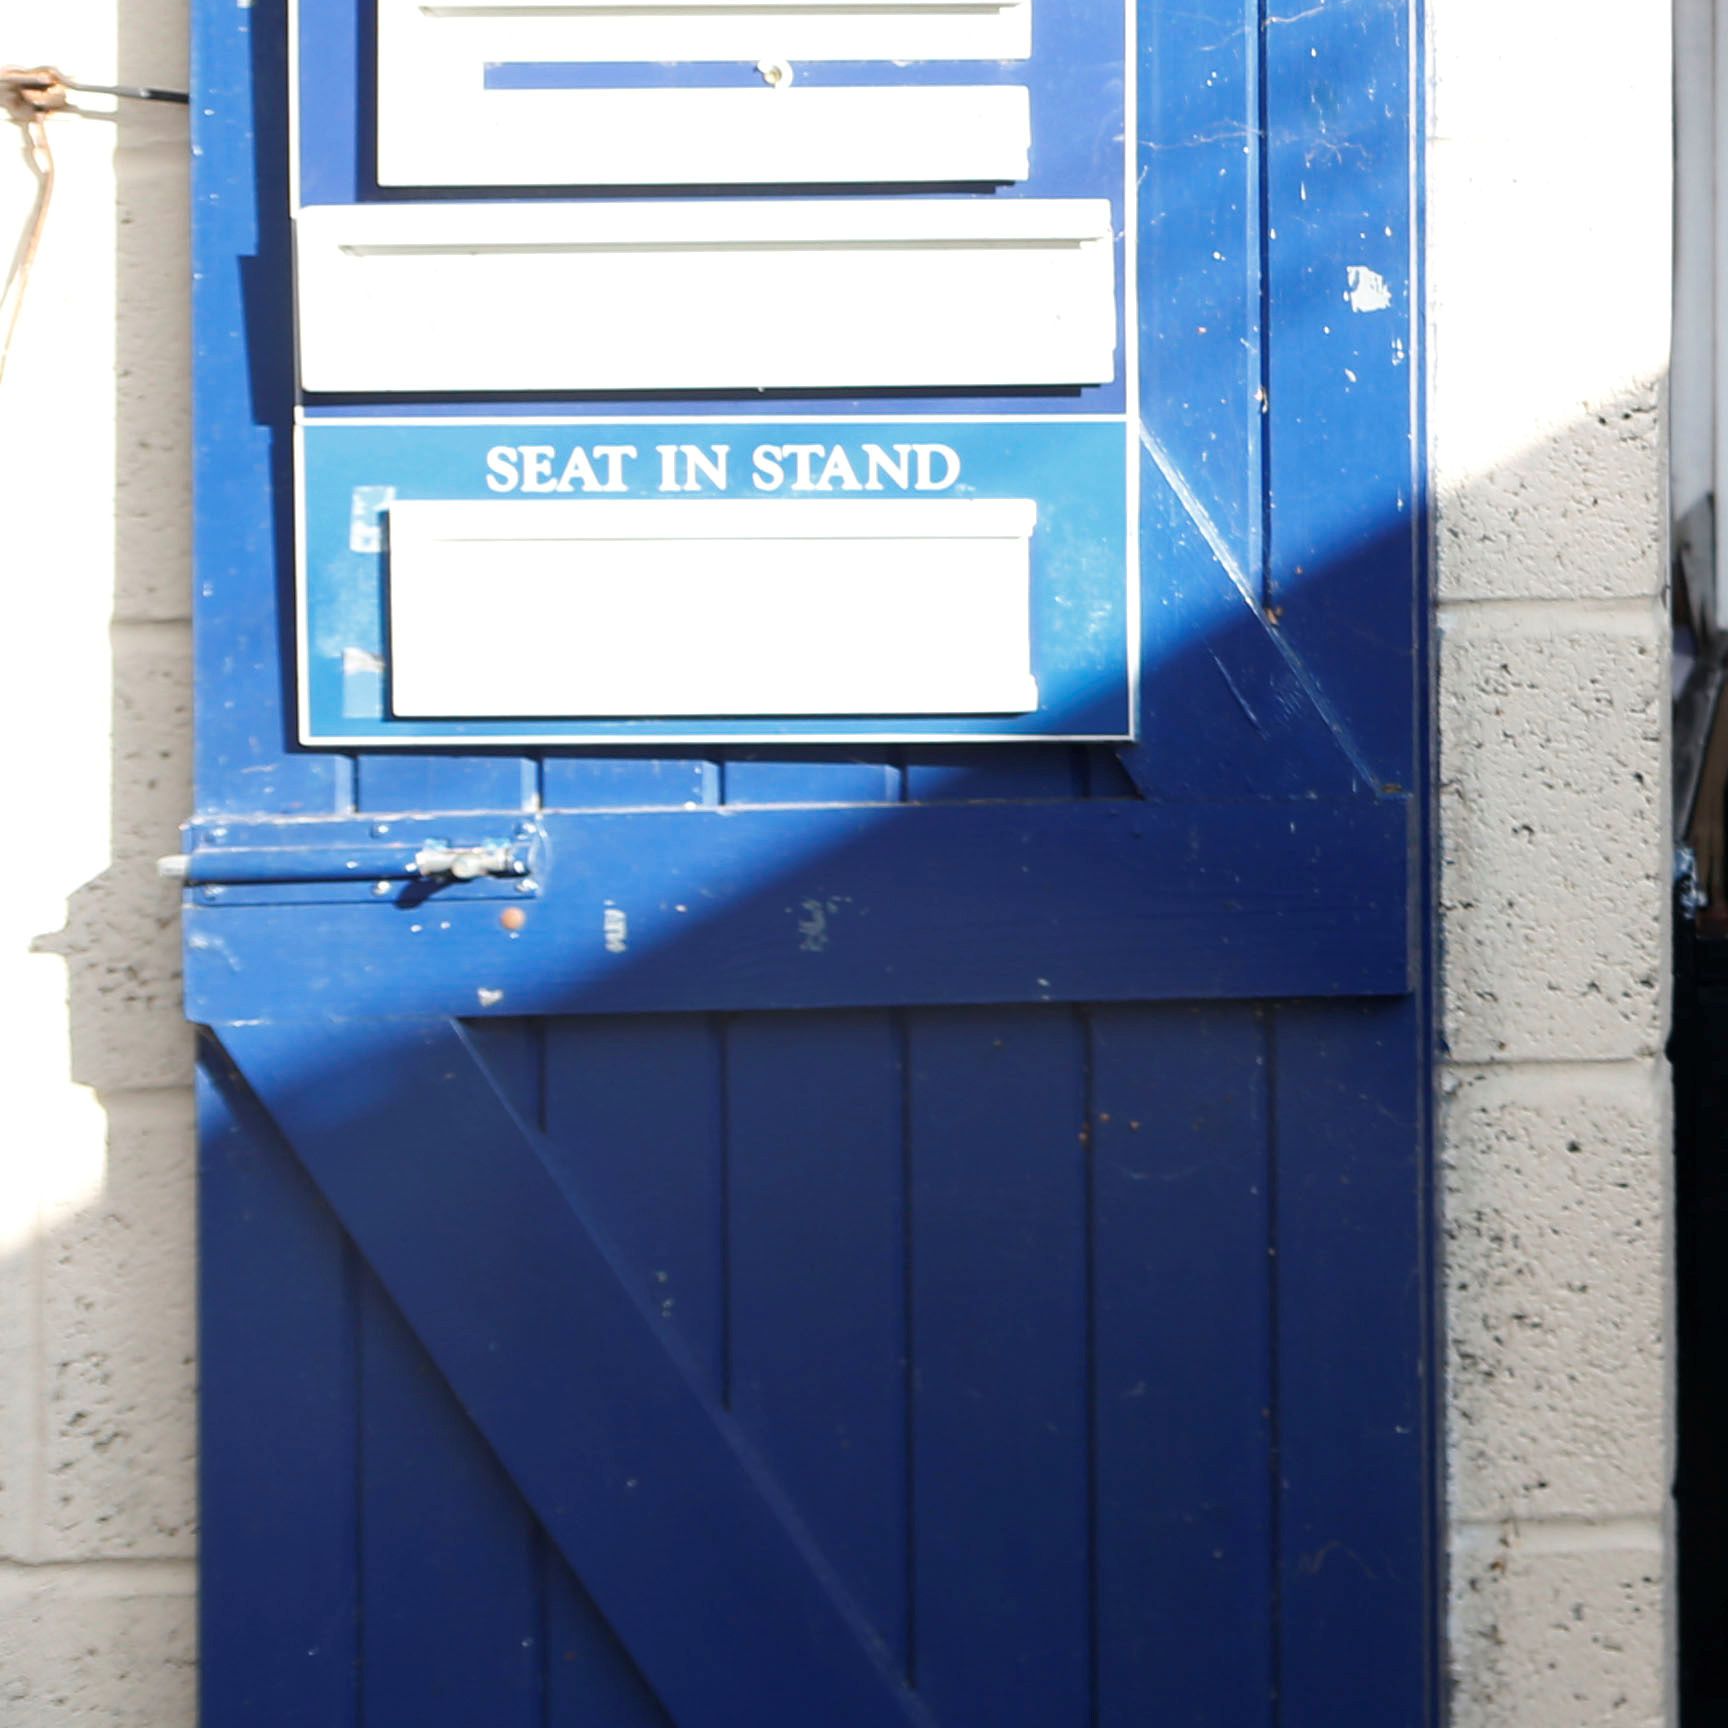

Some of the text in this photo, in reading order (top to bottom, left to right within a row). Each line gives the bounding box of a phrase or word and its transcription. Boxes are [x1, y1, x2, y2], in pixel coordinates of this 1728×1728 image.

[485, 444, 962, 493] SEAT IN STAND
